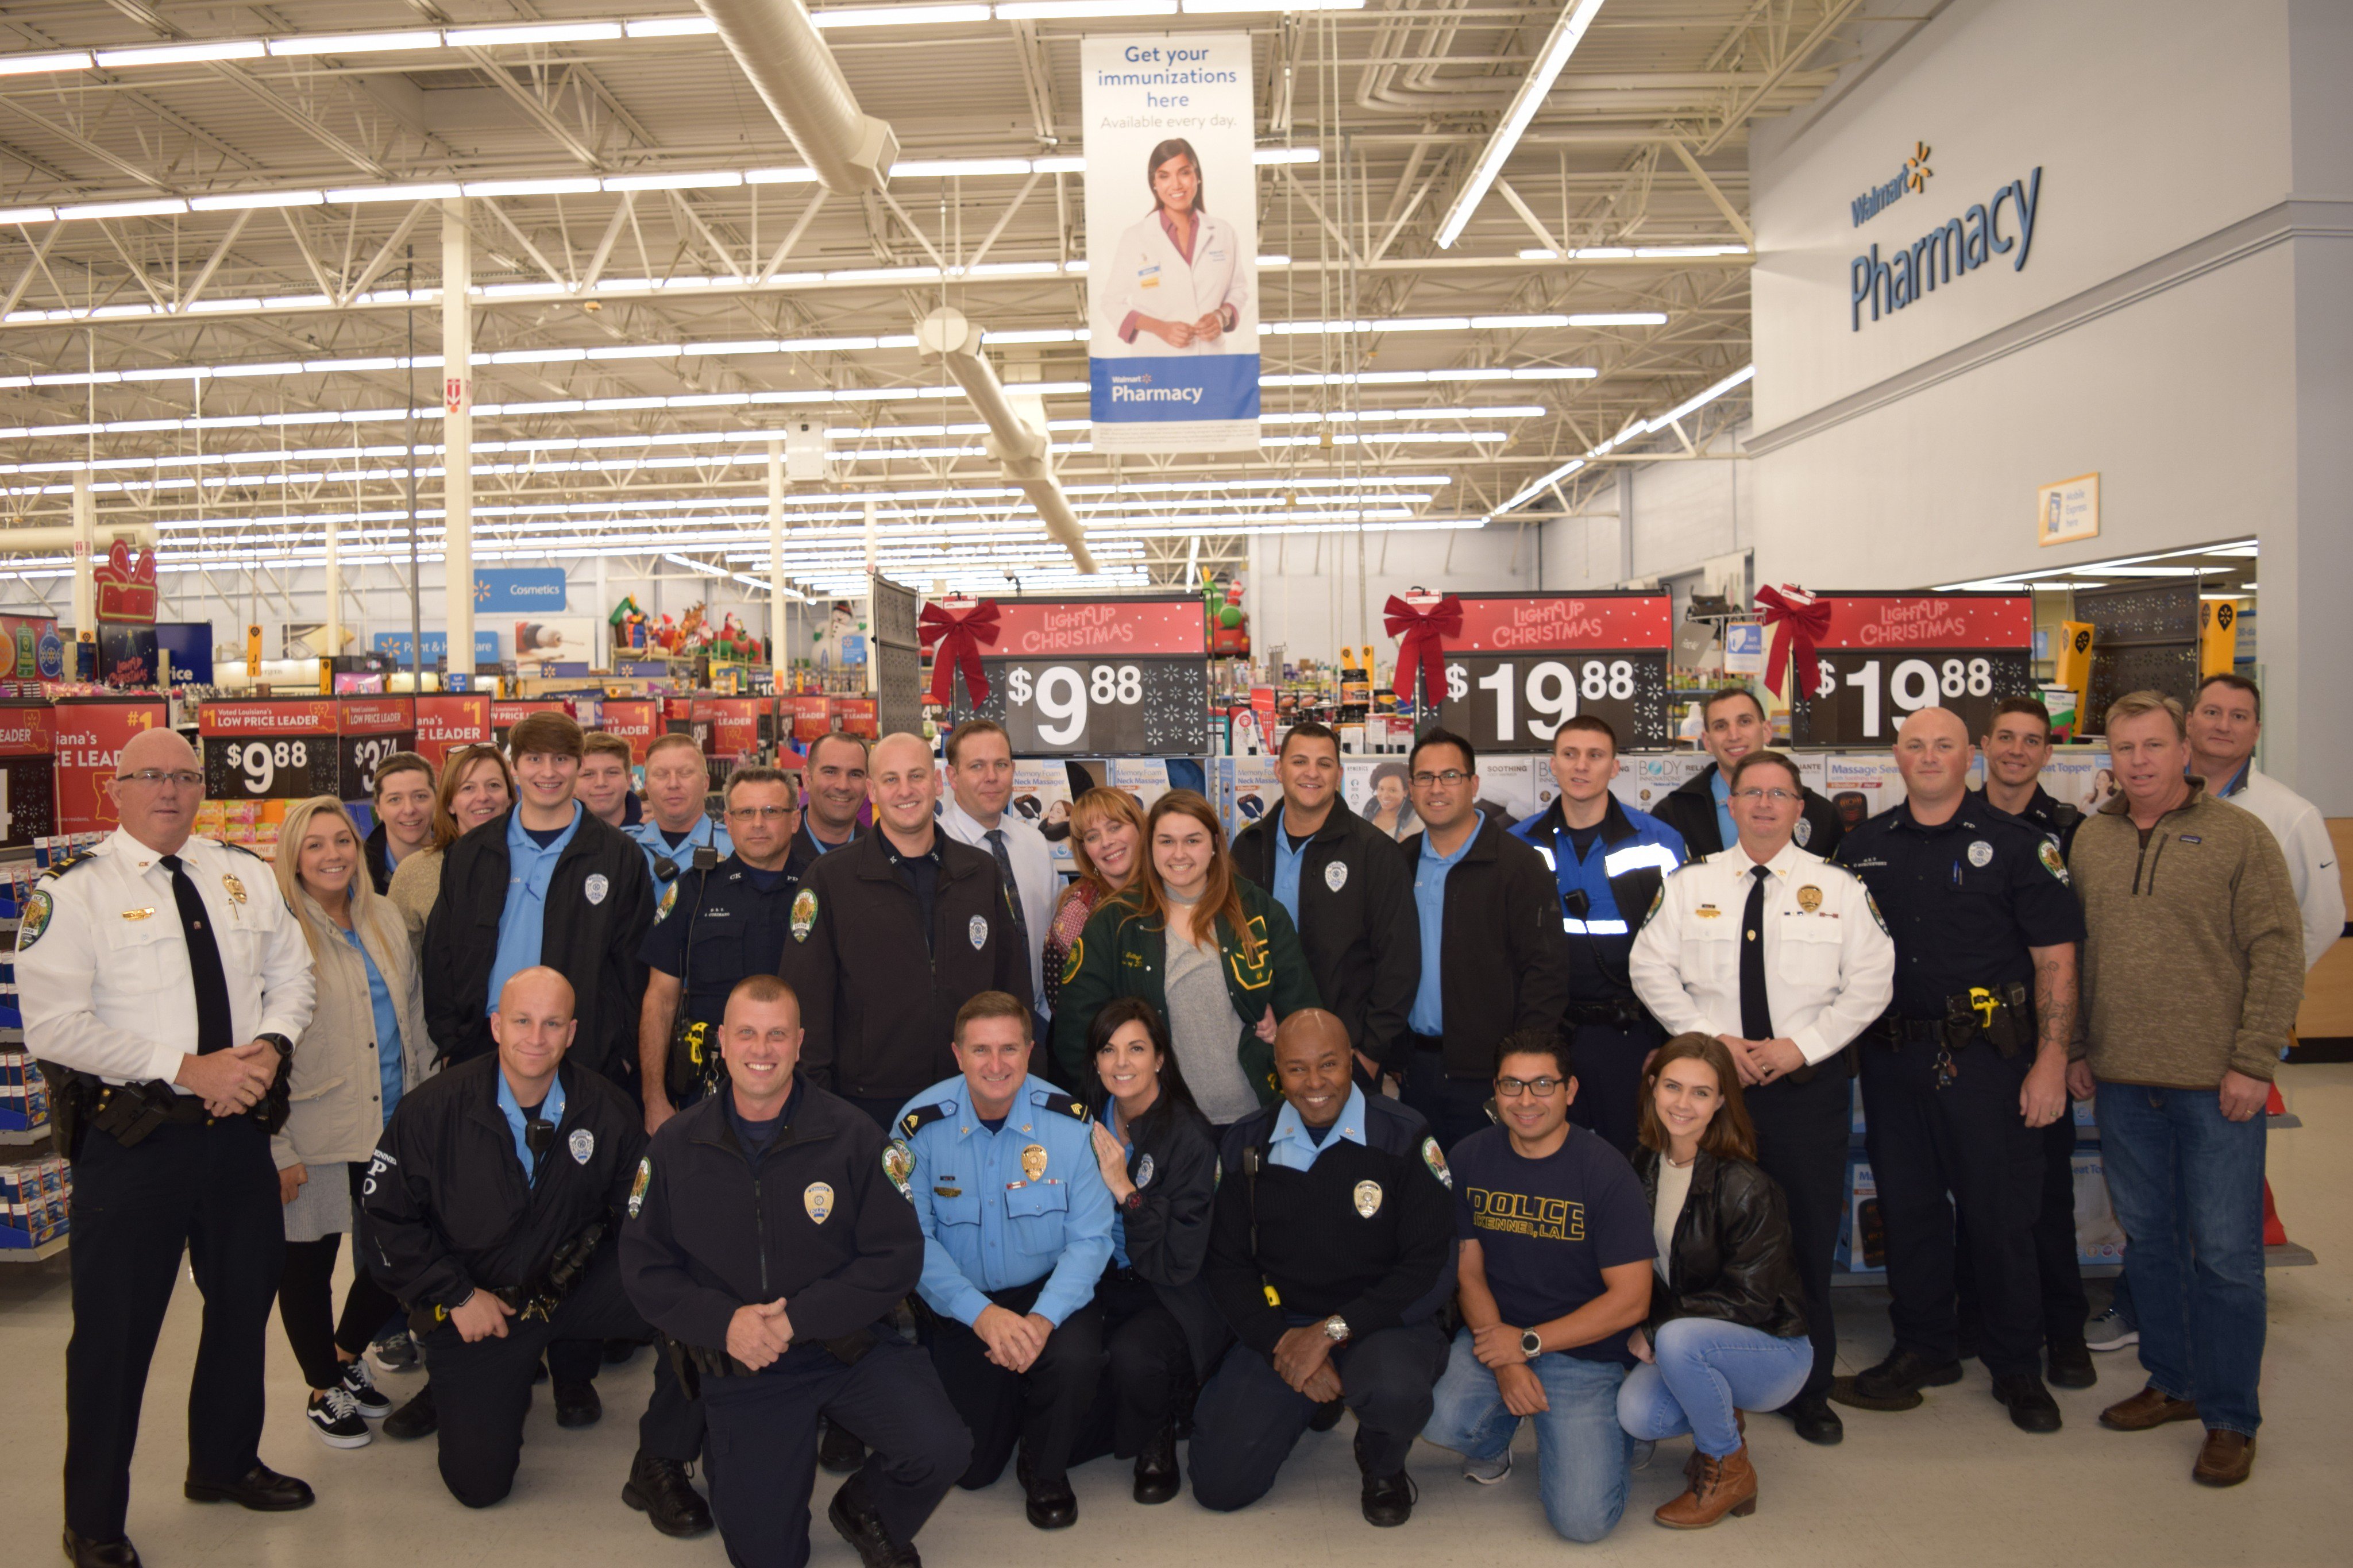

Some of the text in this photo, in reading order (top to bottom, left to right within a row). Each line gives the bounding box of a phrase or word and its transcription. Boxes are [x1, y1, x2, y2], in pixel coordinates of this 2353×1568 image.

[1125, 46, 1209, 66] Get your
[1098, 69, 1237, 86] immunizations
[1147, 92, 1190, 107] here
[1101, 114, 1237, 130] Available every day.
[1851, 163, 1909, 227] Walmart
[1851, 166, 2042, 331] Pharmacy
[1112, 385, 1202, 404] Pharmacy
[510, 584, 560, 595] Cosmetics
[1023, 623, 1133, 652] CHRISTMAS
[1493, 618, 1602, 647] CHRISTMAS
[1861, 617, 1965, 646] CHRISTMAS
[404, 642, 429, 652] Pant
[350, 713, 401, 725] LOW PRICE LEADER
[463, 701, 480, 725] #1
[218, 715, 319, 727] LOW PRICE LEADER
[718, 717, 751, 725] LEADER
[429, 728, 480, 740] LEADER
[609, 726, 649, 735] LEADER
[1832, 765, 1877, 775] Massage
[2058, 763, 2092, 774] Topper
[1467, 1187, 1585, 1241] POLICE
[1540, 1224, 1560, 1239] LA
